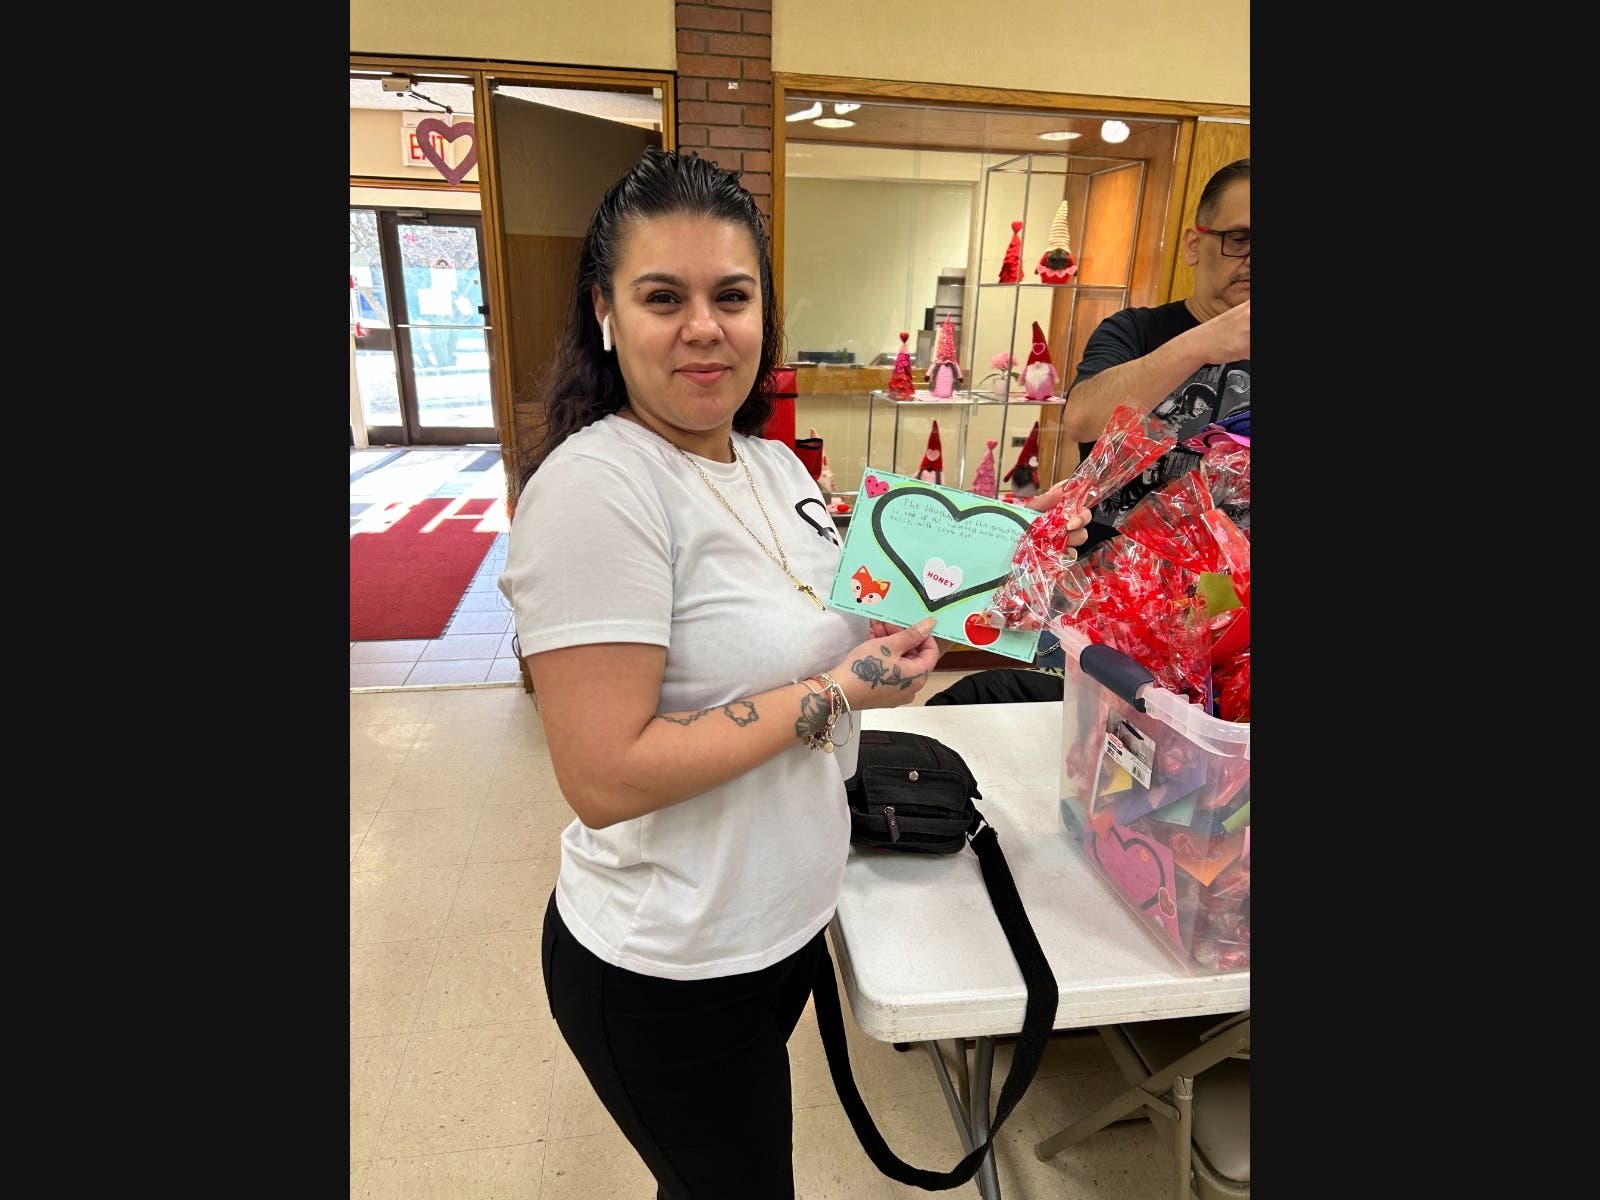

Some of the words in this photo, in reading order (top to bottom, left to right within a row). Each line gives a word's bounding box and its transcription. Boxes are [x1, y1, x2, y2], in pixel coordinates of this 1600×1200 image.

[409, 133, 445, 161] EIT
[904, 498, 920, 510] The
[927, 571, 955, 588] HONEY
